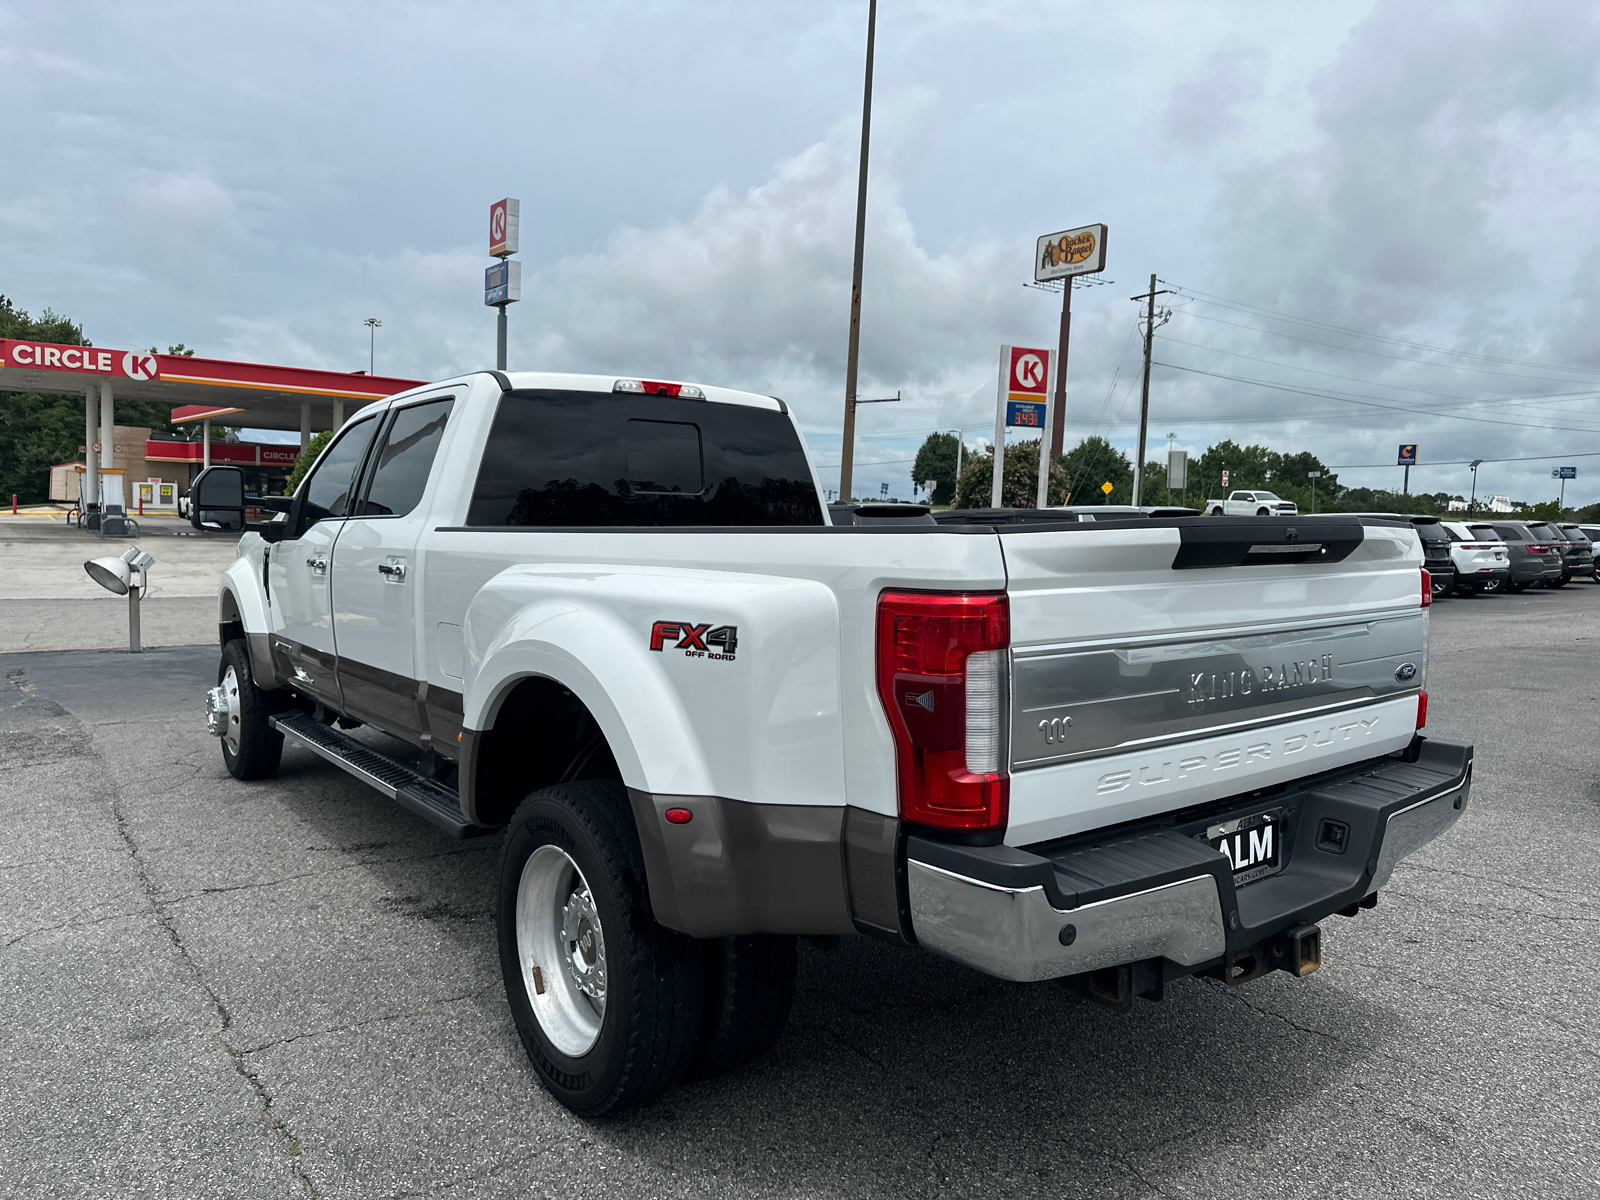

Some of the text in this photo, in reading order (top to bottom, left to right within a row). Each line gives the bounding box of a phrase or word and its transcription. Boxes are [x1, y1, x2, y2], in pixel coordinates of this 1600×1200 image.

[1059, 234, 1091, 252] Cracker
[1065, 243, 1092, 262] Barrel
[12, 344, 156, 380] CIRCLE K
[1021, 358, 1041, 386] K
[262, 452, 294, 460] CIRCLE
[649, 620, 738, 654] FX4
[685, 650, 736, 661] OFF ROAD
[1187, 654, 1333, 703] KING RANCH
[1097, 717, 1379, 795] SUPER DUTY
[1236, 816, 1256, 830] ALM
[1220, 824, 1272, 870] ALM
